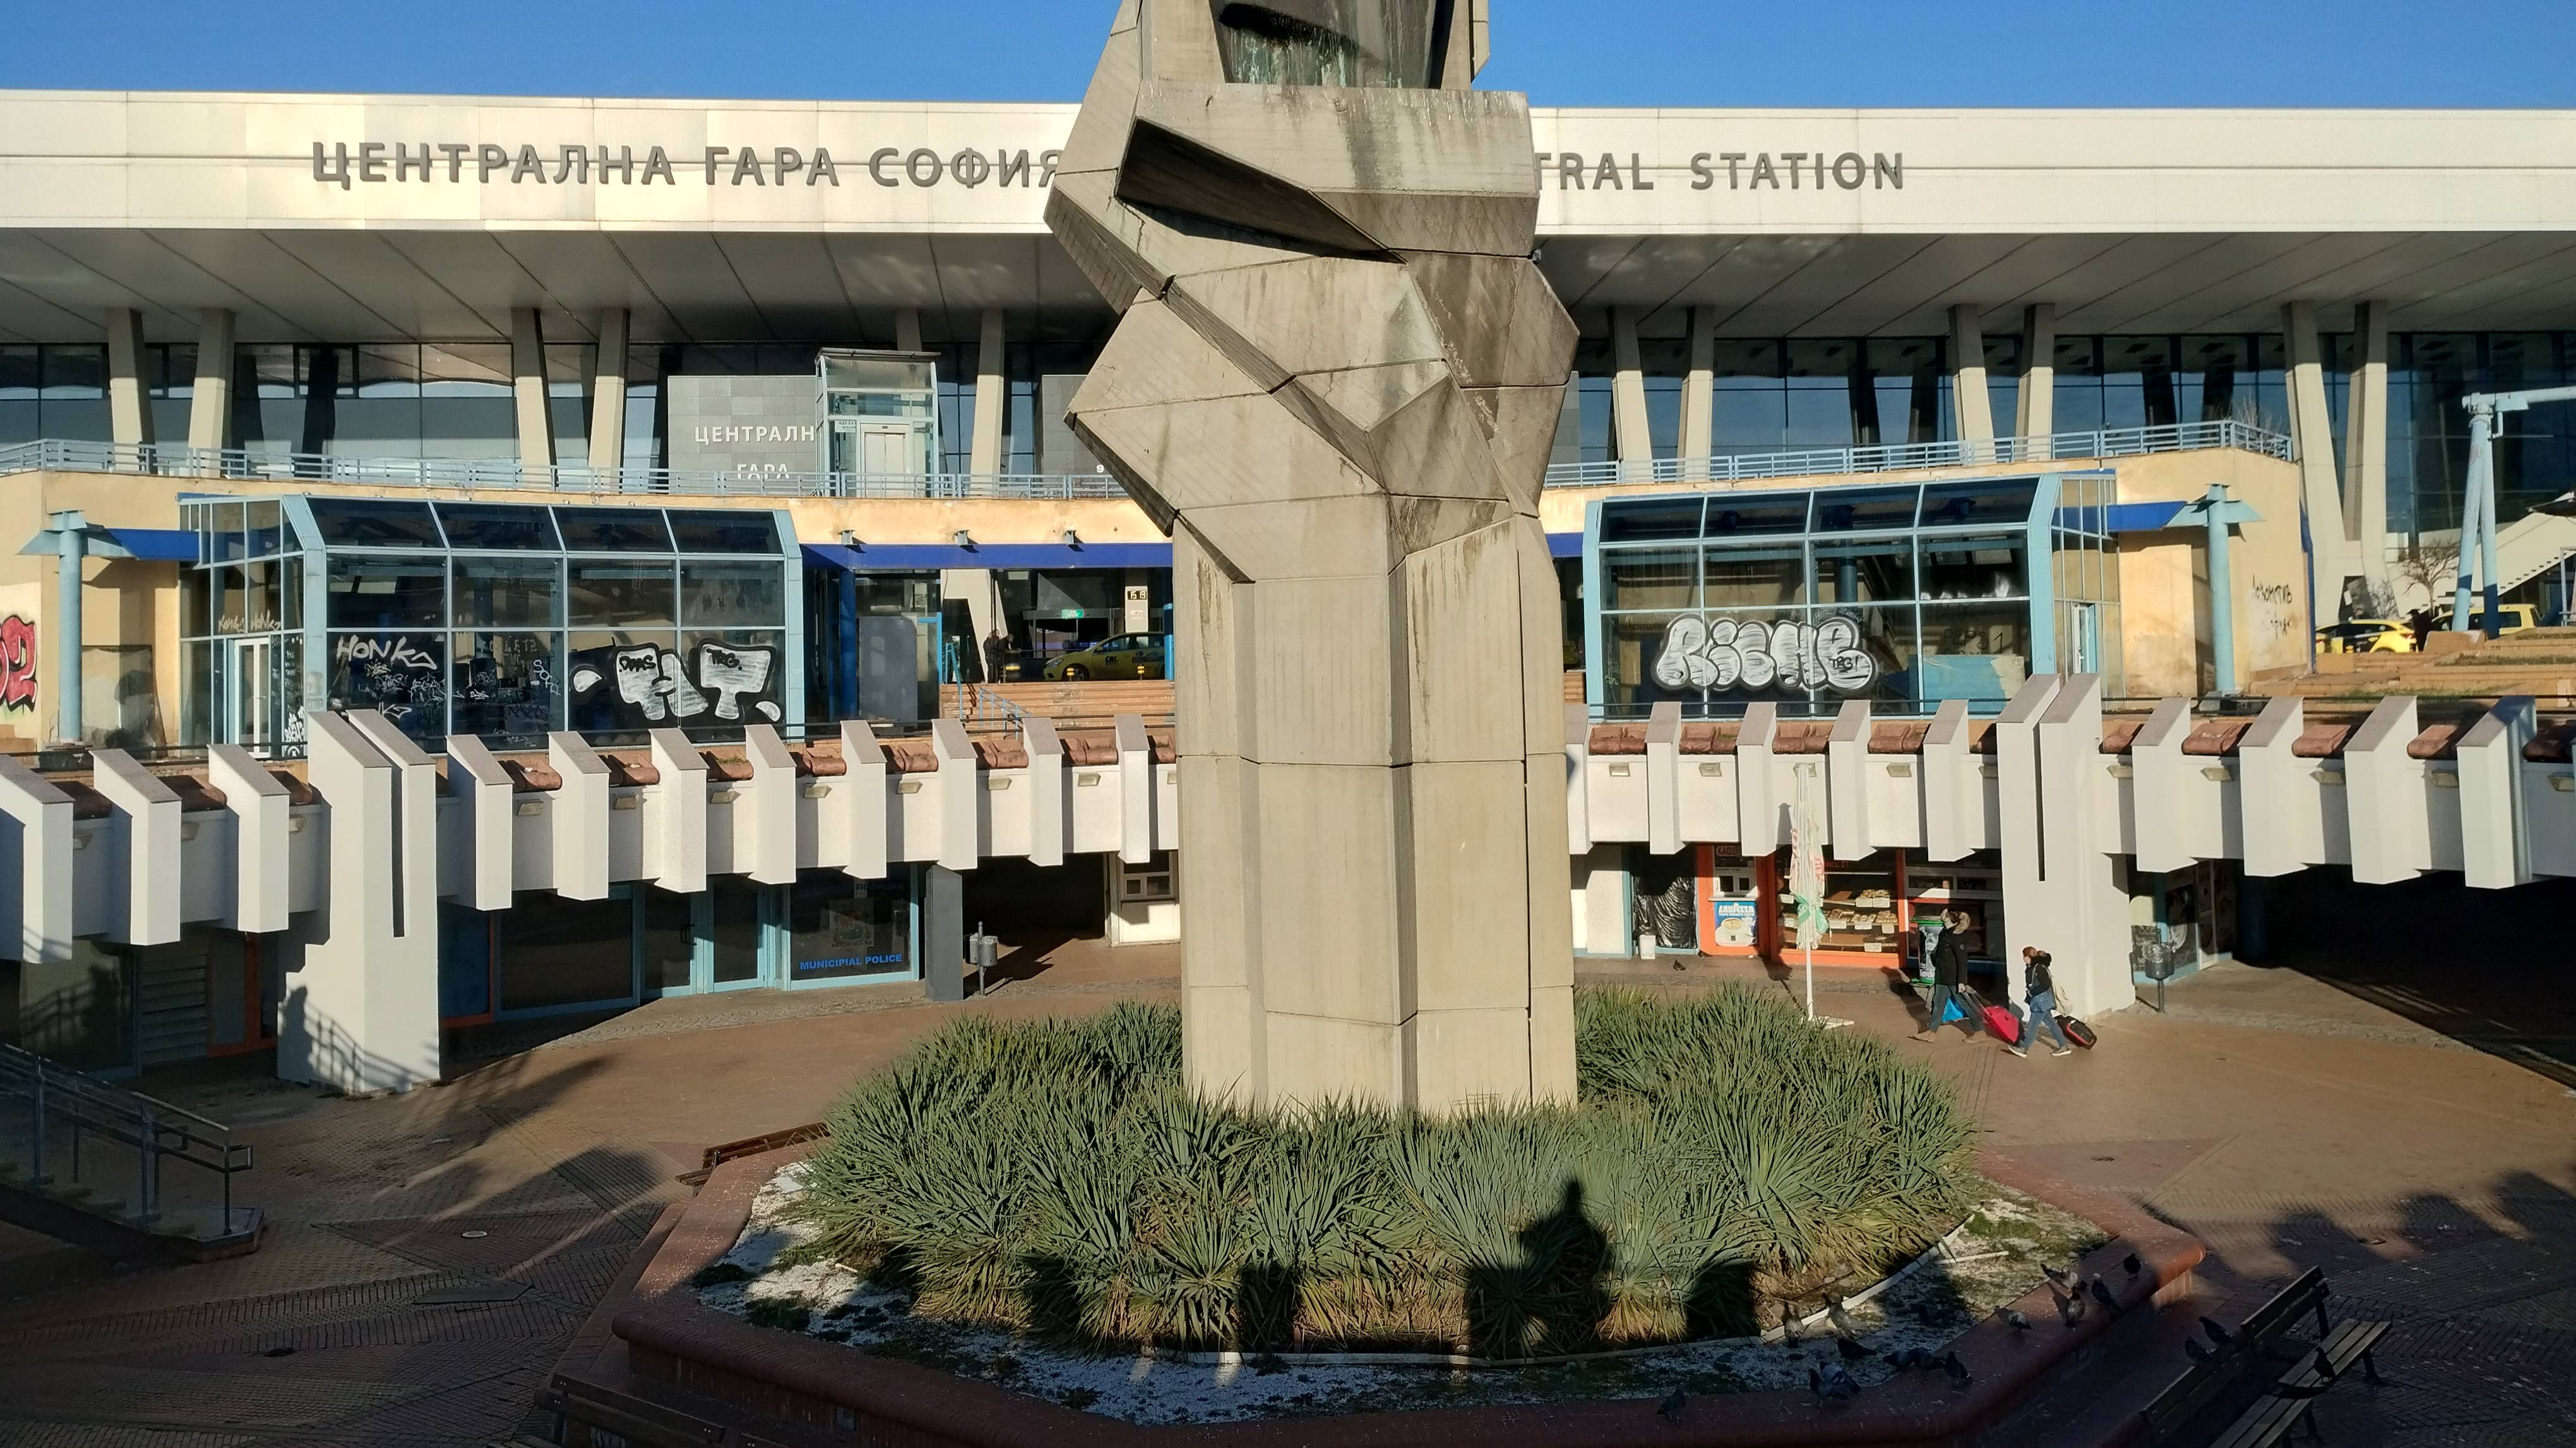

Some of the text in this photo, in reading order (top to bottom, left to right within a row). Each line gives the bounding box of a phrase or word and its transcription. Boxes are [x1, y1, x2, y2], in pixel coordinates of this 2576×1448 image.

[313, 141, 1064, 191] ЦЕНТРАЛНА ГАРА СОФИЯ
[1690, 152, 1904, 191] STATION
[737, 464, 790, 479] ГАРА
[799, 954, 903, 971] MUNICIPIAL POLICE
